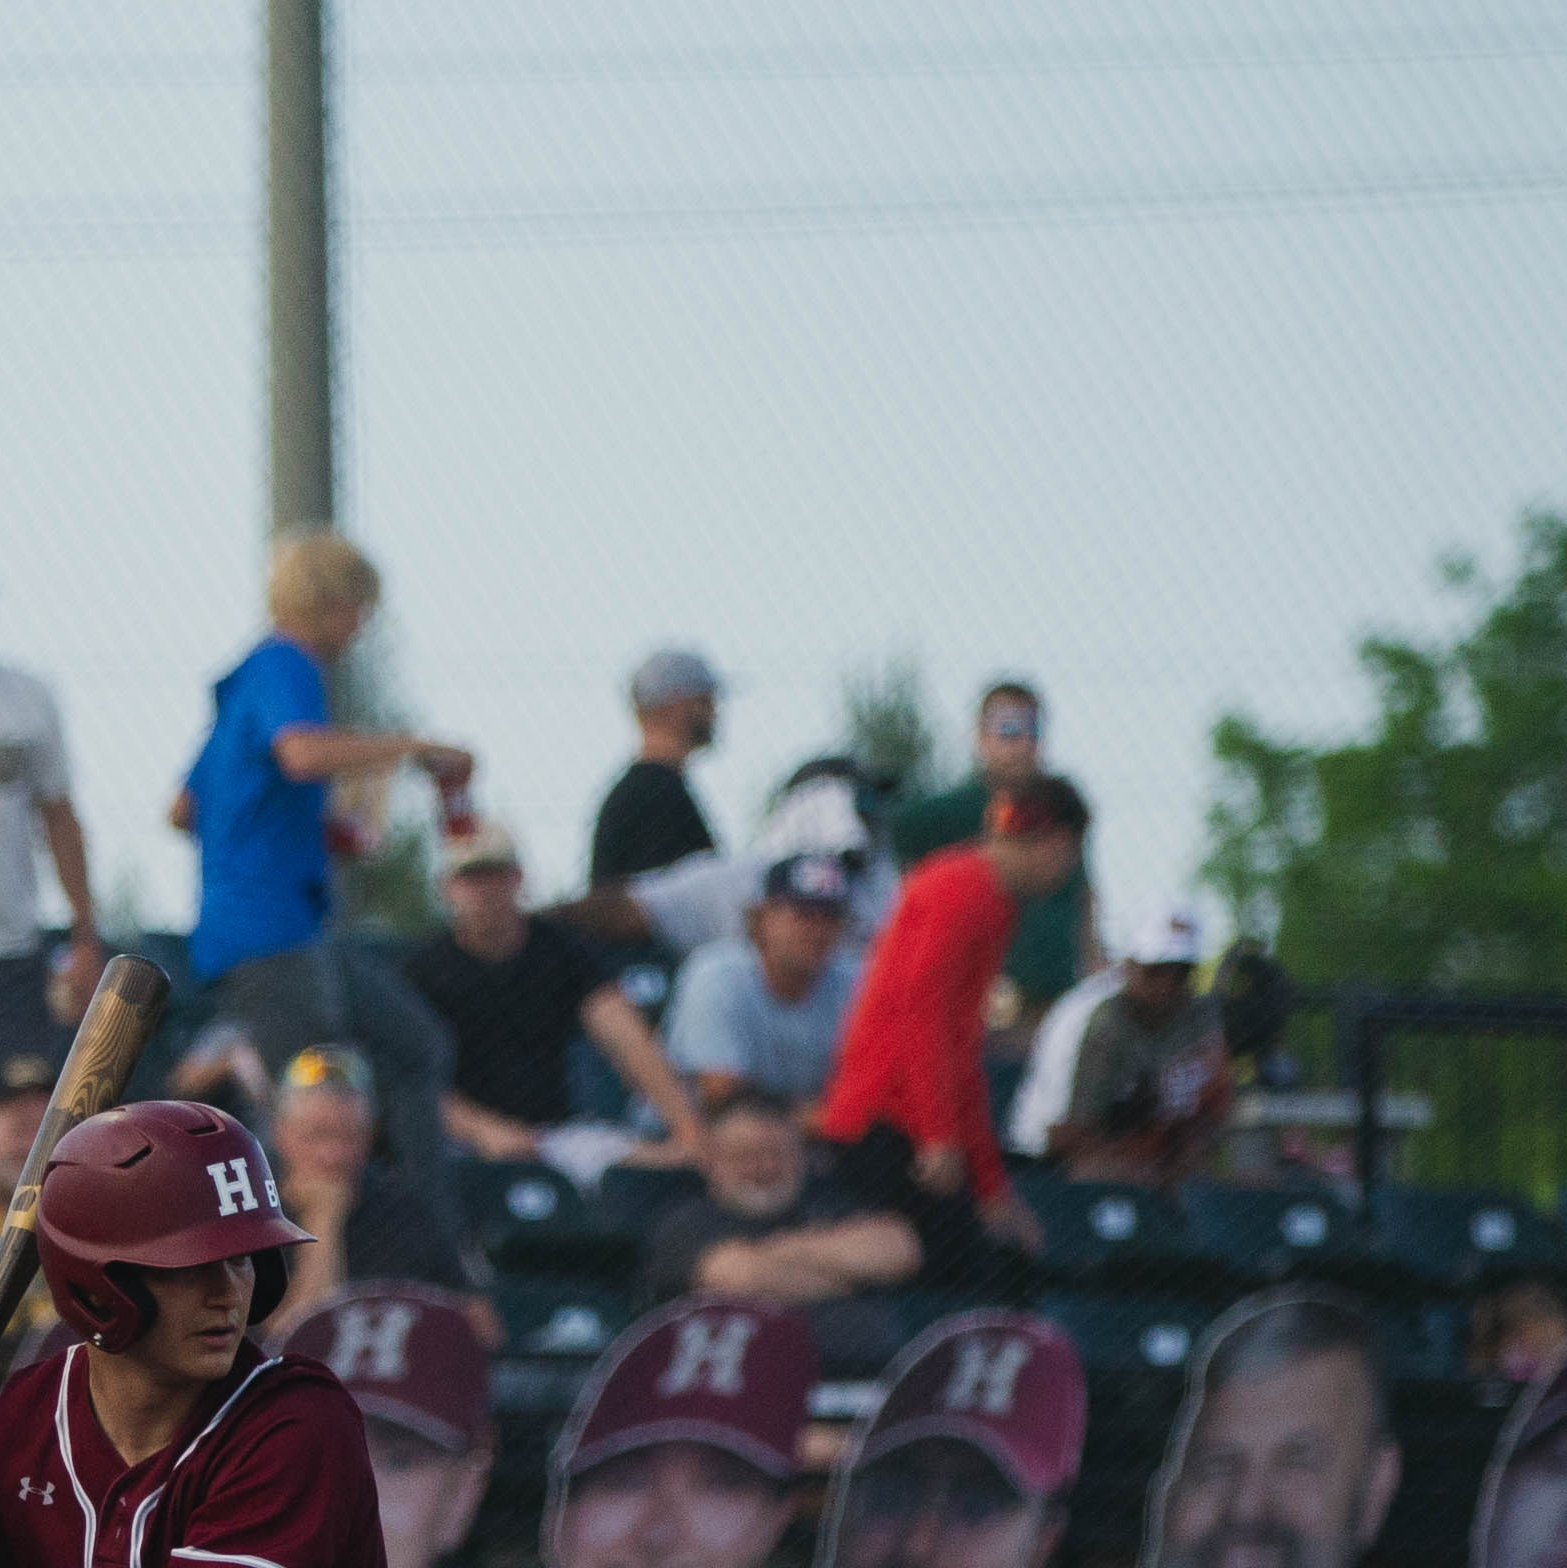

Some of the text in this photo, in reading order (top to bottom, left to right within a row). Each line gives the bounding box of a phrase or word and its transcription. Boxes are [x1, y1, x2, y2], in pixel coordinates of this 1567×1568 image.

[206, 1157, 259, 1216] H
[320, 1303, 417, 1381] H
[661, 1310, 758, 1396] H
[944, 1337, 1031, 1414] H
